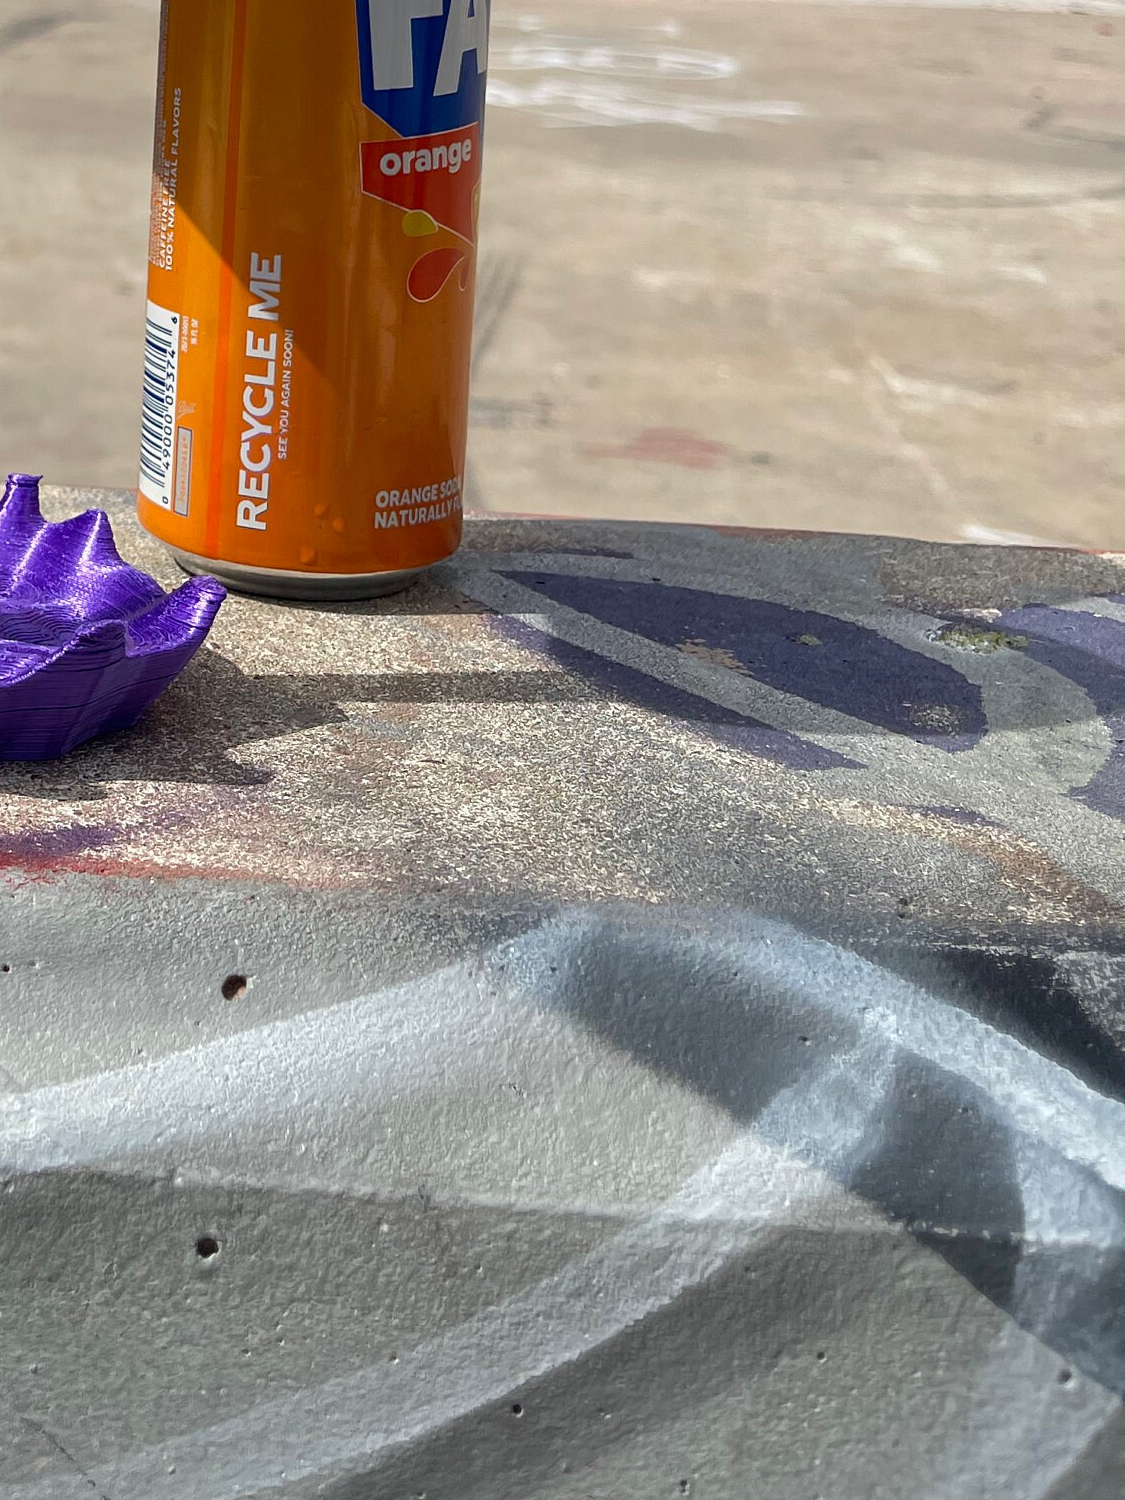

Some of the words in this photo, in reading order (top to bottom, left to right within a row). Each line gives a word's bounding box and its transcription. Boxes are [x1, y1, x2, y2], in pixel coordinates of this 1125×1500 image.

[171, 87, 182, 156] FLAVORS
[379, 138, 473, 177] orange
[162, 160, 171, 195] FREE
[167, 159, 179, 228] NATURAL
[159, 197, 170, 269] CAFFEINE
[165, 231, 175, 271] 100%
[247, 251, 282, 322] ME
[282, 329, 295, 367] SOON!
[280, 370, 292, 408] AGAIN
[236, 329, 278, 531] RECYCLE
[279, 409, 290, 435] YOU
[277, 437, 288, 460] SEE
[375, 483, 440, 509] ORANGE
[440, 474, 462, 499] SOD
[374, 499, 453, 530] NATURALLY
